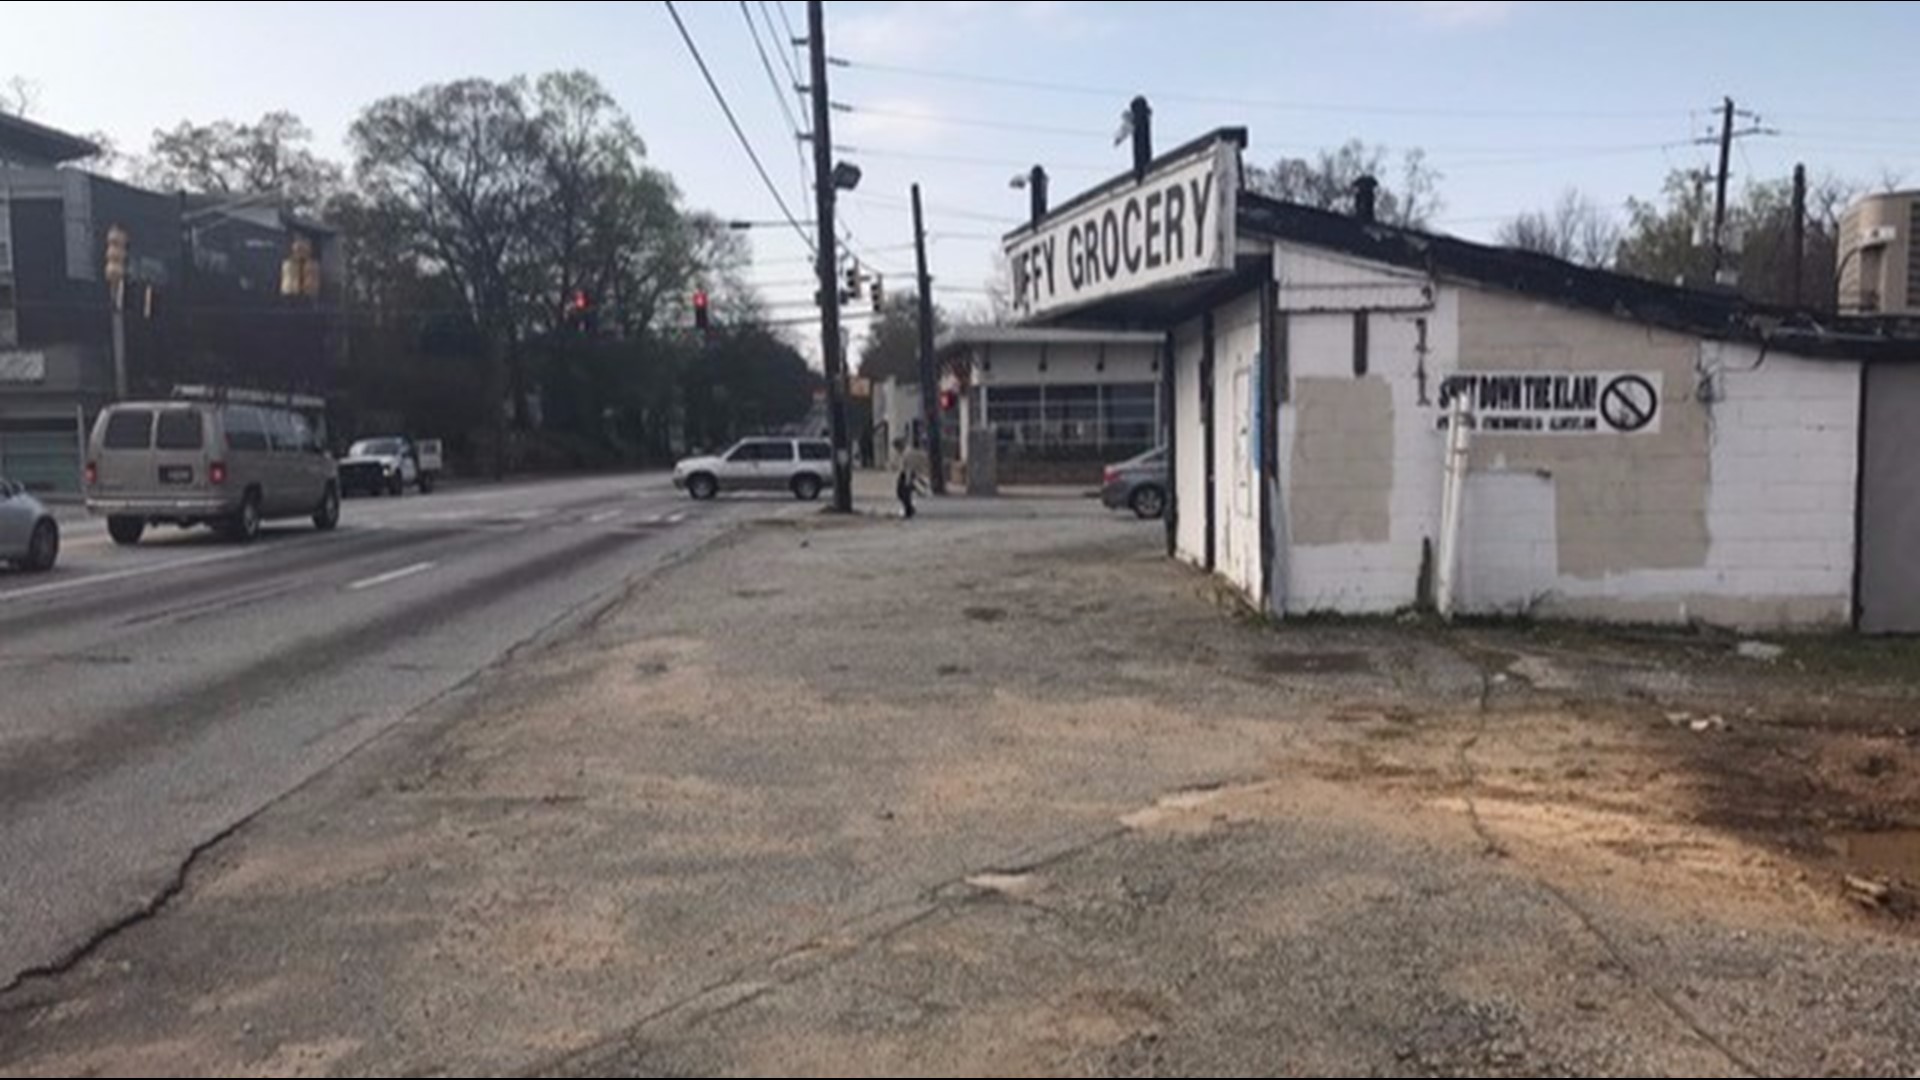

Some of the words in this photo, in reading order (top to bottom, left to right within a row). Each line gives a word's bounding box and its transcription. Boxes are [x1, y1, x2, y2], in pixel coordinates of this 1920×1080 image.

[1067, 172, 1212, 292] GROCERY
[1479, 375, 1523, 409] DOWN
[1524, 375, 1552, 409] THE
